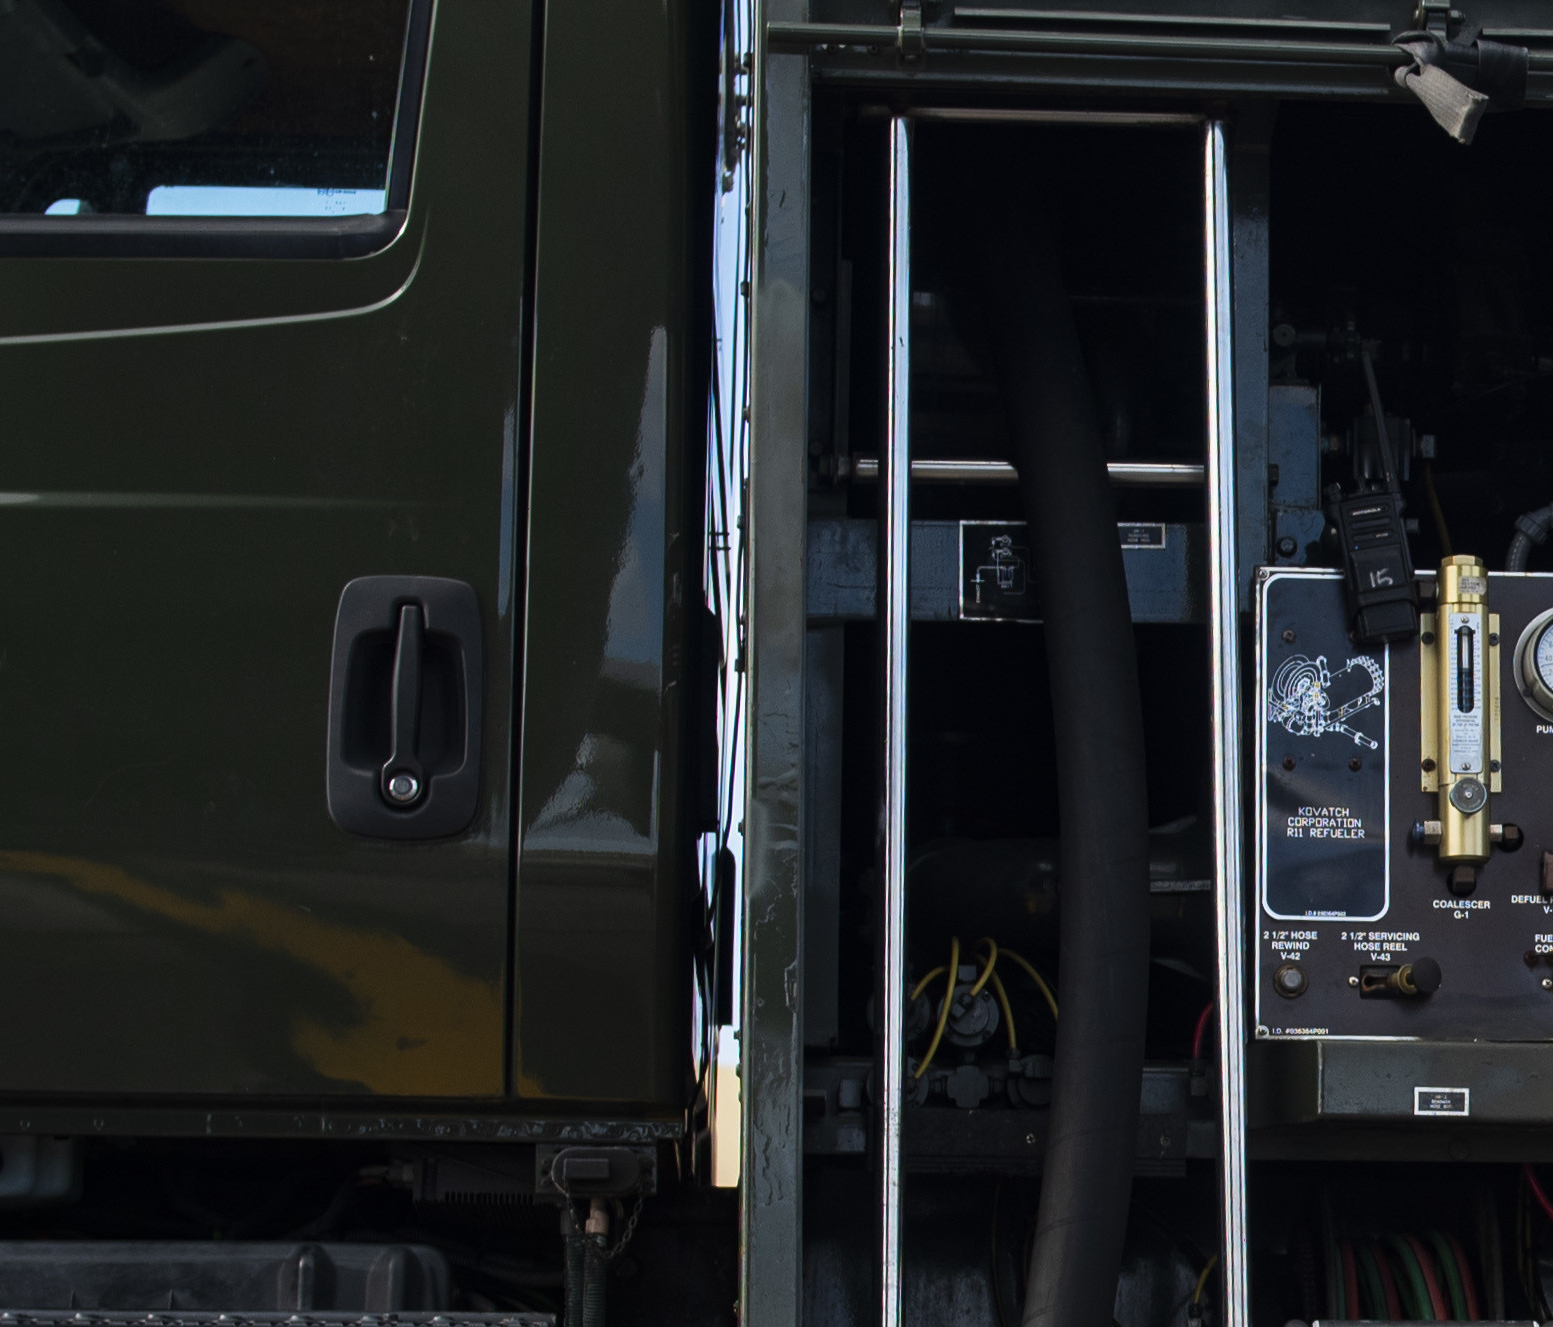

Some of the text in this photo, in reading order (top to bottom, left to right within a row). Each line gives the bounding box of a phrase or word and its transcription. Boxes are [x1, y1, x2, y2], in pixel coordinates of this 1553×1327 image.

[1370, 569, 1393, 588] 15
[1298, 807, 1350, 817] KOVATCH
[1287, 817, 1361, 828] CORPORATION
[1287, 828, 1365, 839] R11 REFUELER
[1511, 895, 1547, 904] DEFUEL
[1433, 900, 1491, 910] COALESCER
[1453, 910, 1469, 920] G-1
[1263, 931, 1318, 940] 2 1/2" HOSE
[1341, 932, 1420, 942] 2 1/2" SERVICING
[1271, 942, 1310, 950] REWIND
[1353, 942, 1407, 952] HOSE REEL
[1281, 952, 1301, 960] V-42
[1371, 952, 1391, 962] V-43
